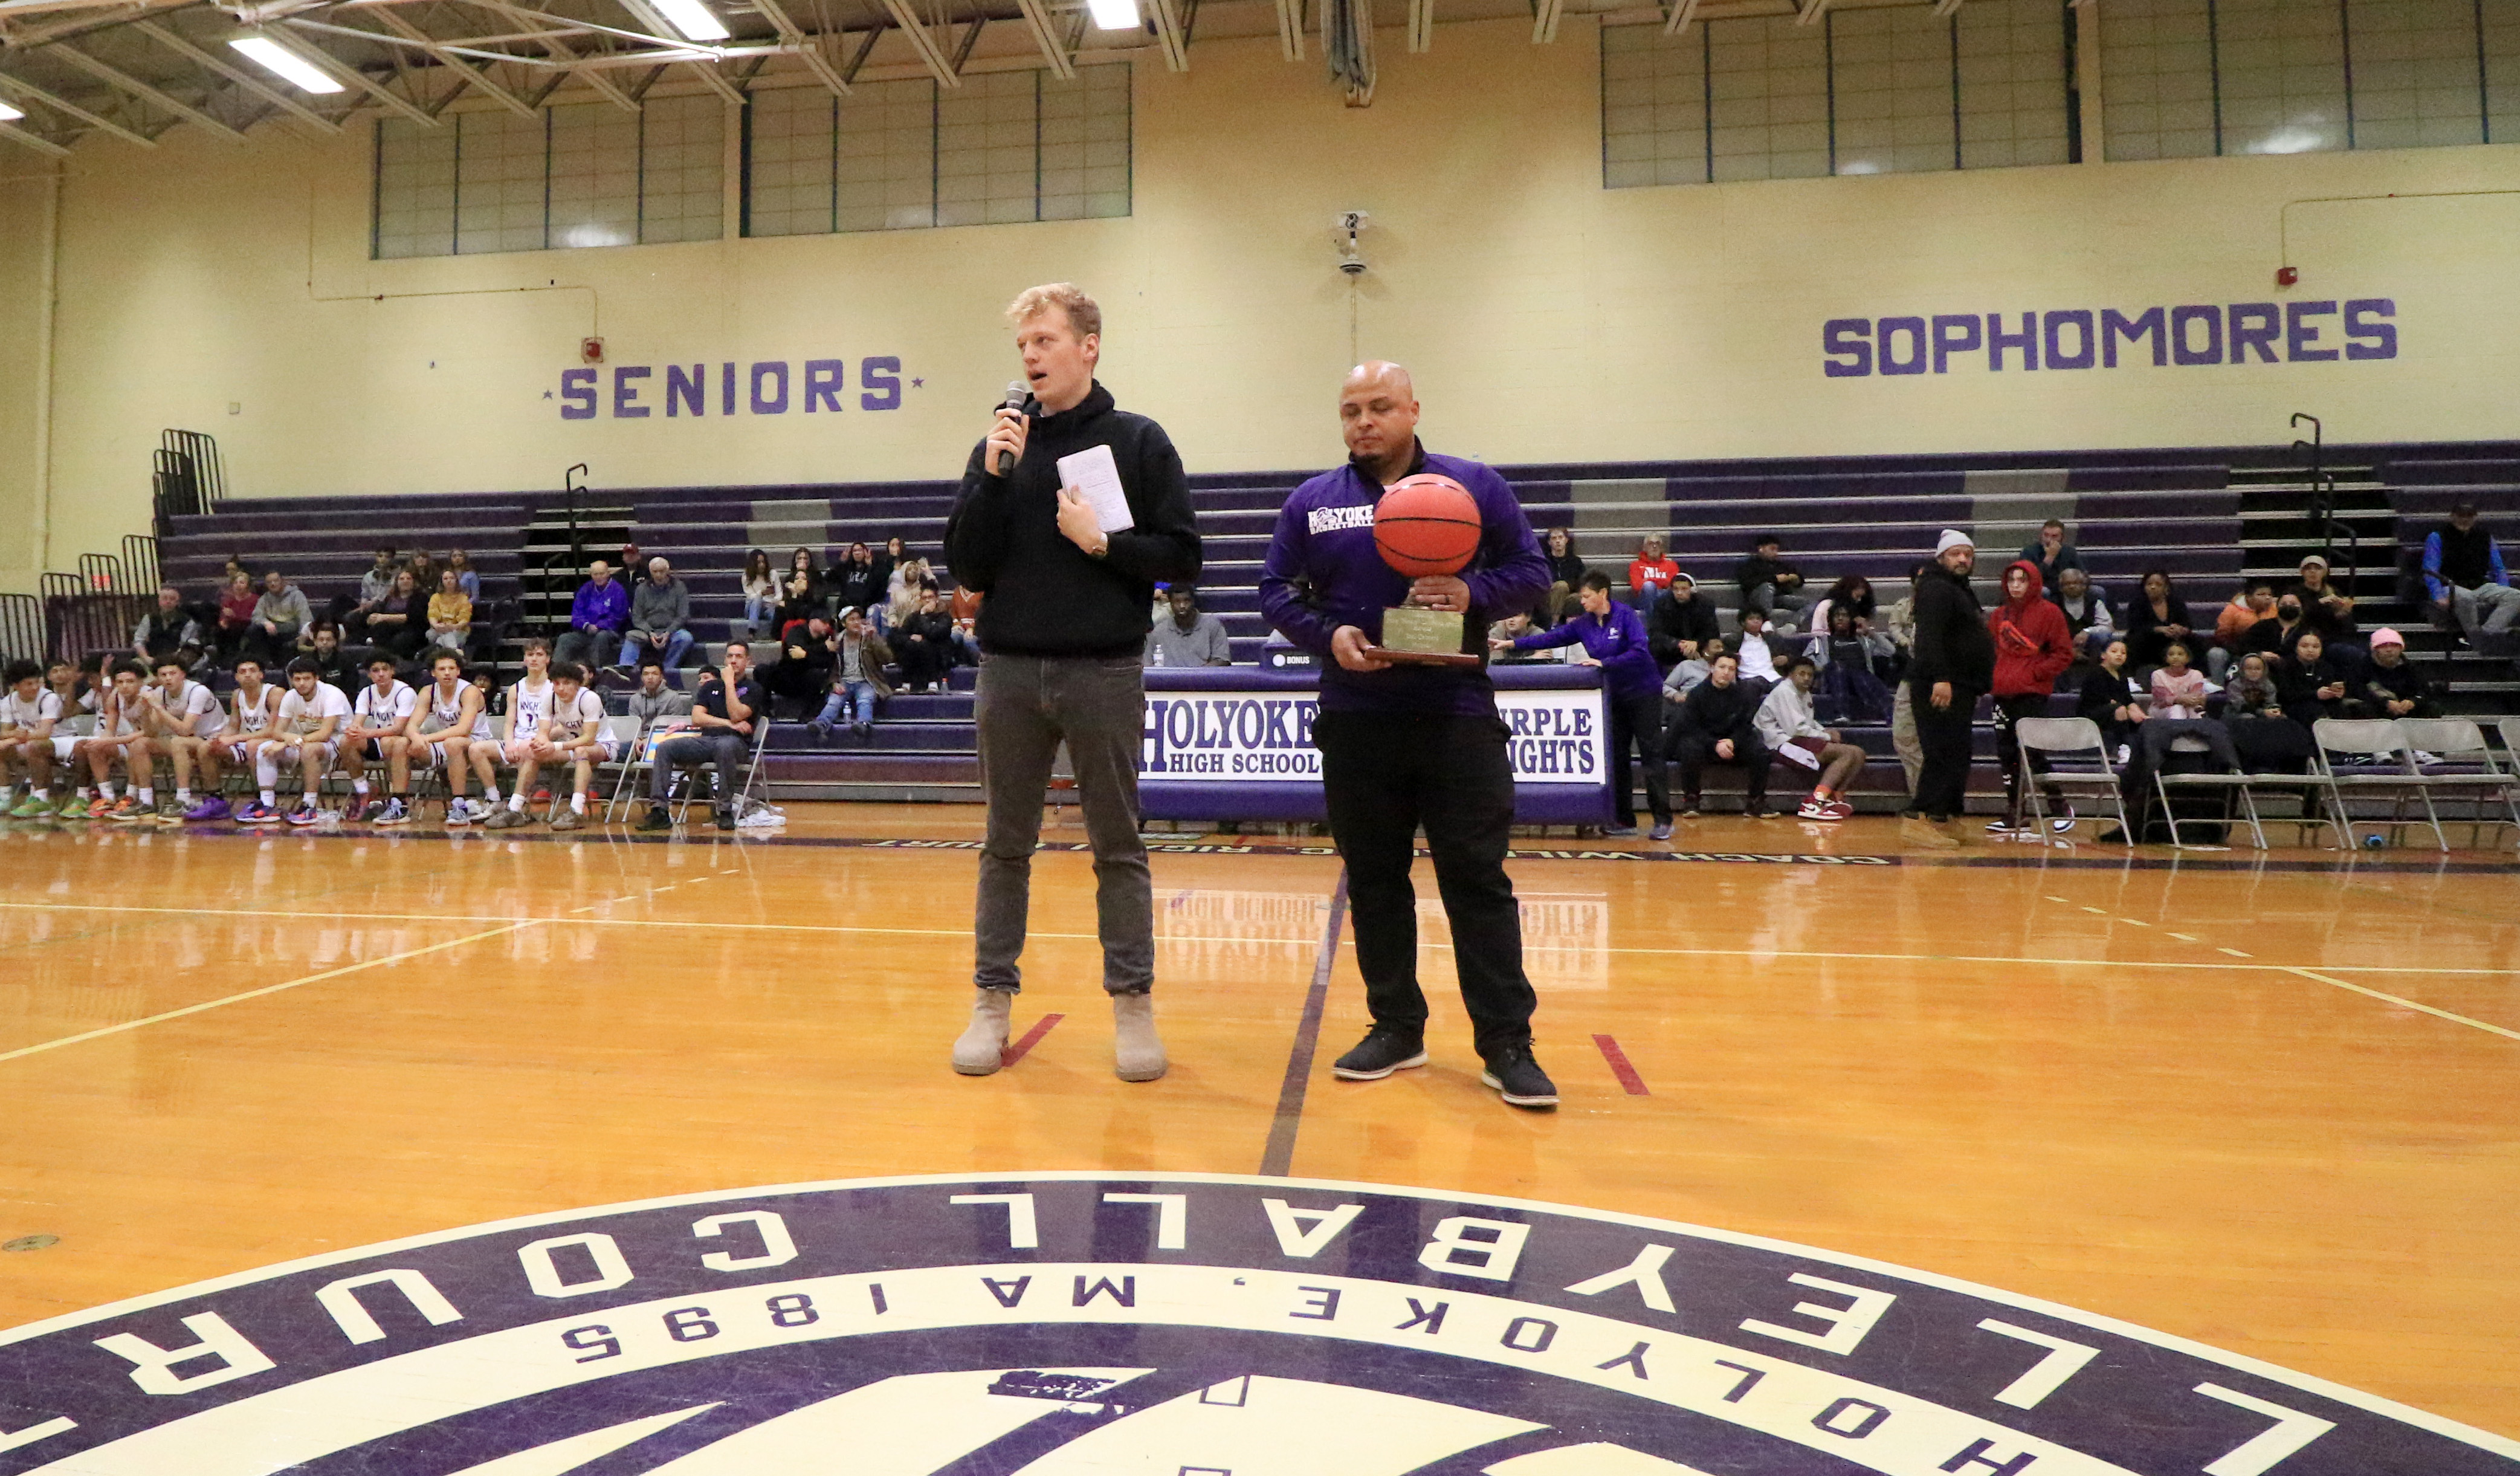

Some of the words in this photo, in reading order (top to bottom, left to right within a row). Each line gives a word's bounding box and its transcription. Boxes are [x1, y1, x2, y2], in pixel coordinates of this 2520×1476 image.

[1823, 299, 2397, 378] SOPHOMORES
[561, 357, 901, 419] SENIORS
[1310, 520, 1375, 535] BASKETBALL
[1139, 699, 1320, 772] HOLYOKE
[1170, 754, 1224, 772] HIGH
[1232, 754, 1319, 774] SCHOOL
[862, 840, 1047, 849] URT
[1672, 853, 1890, 864] COACH
[980, 1276, 1135, 1308] MA
[560, 1283, 890, 1365] 1895
